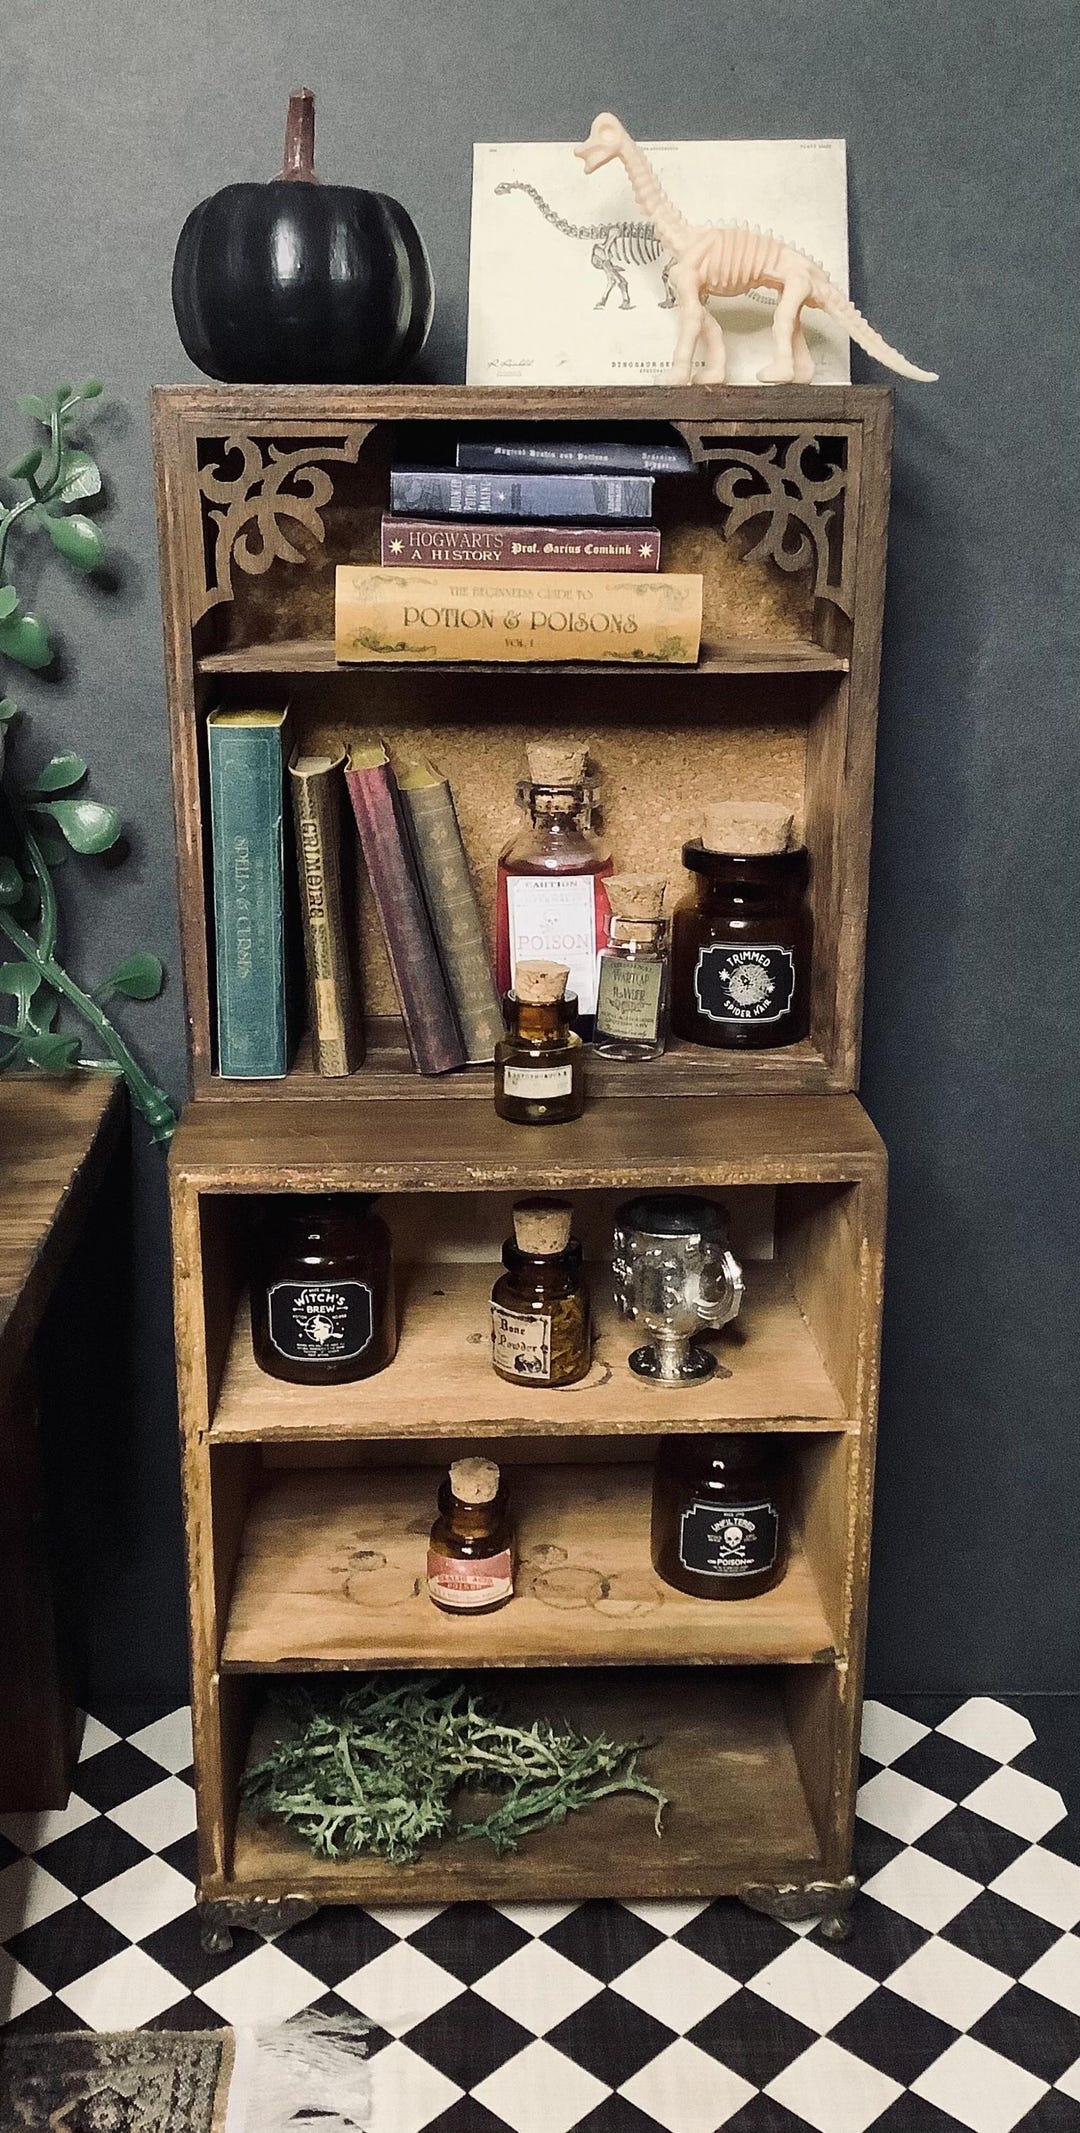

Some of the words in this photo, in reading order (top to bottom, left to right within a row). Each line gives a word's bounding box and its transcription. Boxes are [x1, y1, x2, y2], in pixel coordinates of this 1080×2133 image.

[409, 531, 504, 548] HOGWARTS
[411, 550, 422, 560] A
[432, 550, 502, 561] HISTORY
[511, 542, 540, 555] Prof.
[450, 586, 468, 597] THE
[536, 588, 573, 600] GUIDE
[577, 589, 594, 600] TO
[404, 606, 494, 629] POTION
[503, 609, 523, 630] &
[531, 610, 639, 635] POISONS
[302, 822, 325, 918] GRIMOIRE
[525, 880, 578, 889] CAUTION
[517, 933, 591, 951] POISON
[726, 951, 771, 967] TRIMMED
[723, 999, 752, 1018] SPIDER
[753, 998, 772, 1016] HAIR
[293, 1288, 346, 1307] WITCH'S
[306, 1304, 336, 1314] BREW
[499, 1318, 526, 1335] Bone
[498, 1334, 538, 1352] Powder
[716, 1558, 747, 1566] POISON
